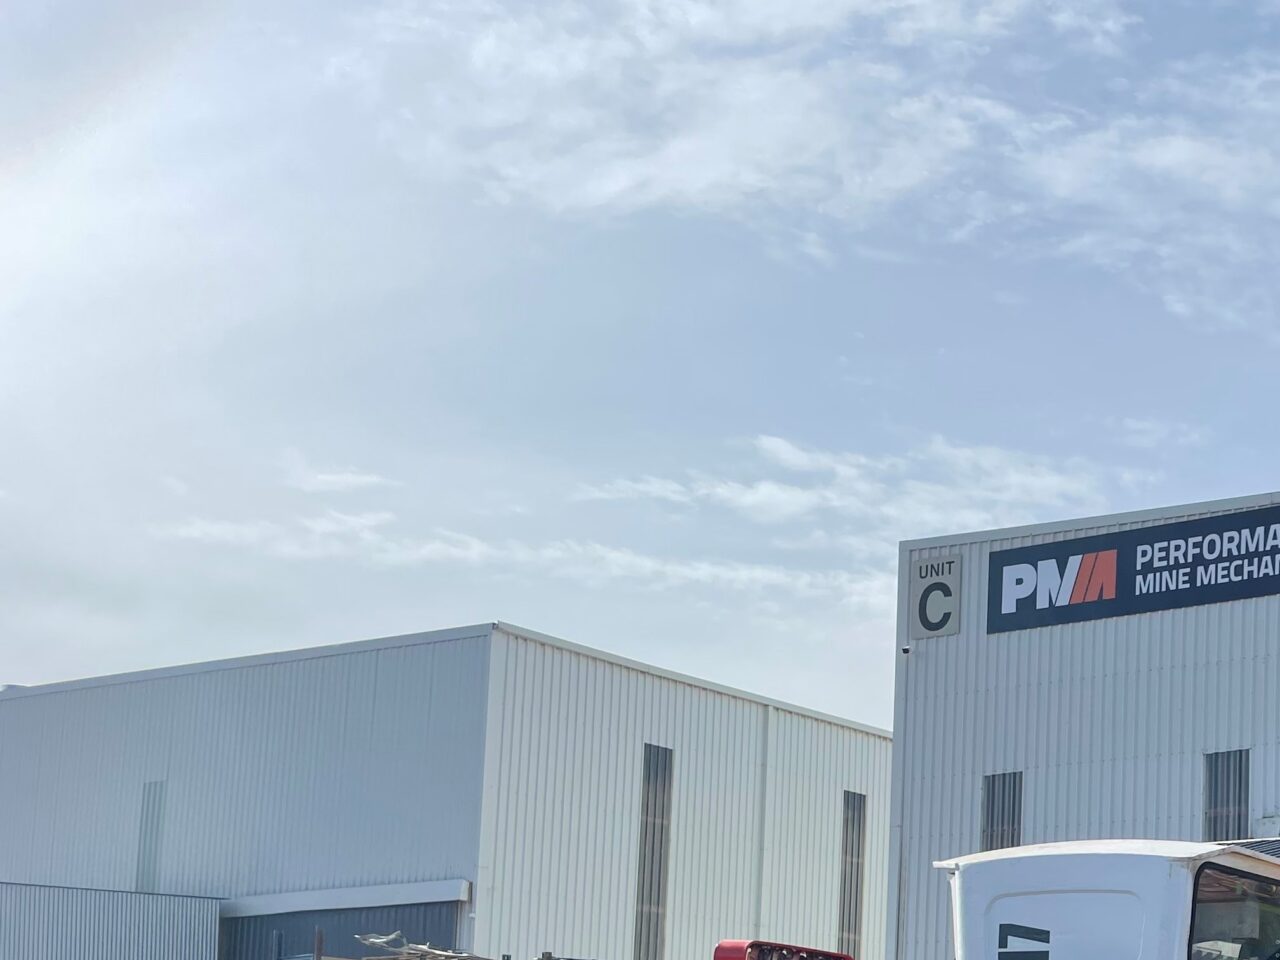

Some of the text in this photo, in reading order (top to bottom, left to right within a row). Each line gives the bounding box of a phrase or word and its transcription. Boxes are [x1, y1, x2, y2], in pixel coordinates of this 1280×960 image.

[919, 560, 955, 579] UNIT
[1135, 568, 1191, 596] MINE
[918, 581, 953, 632] C
